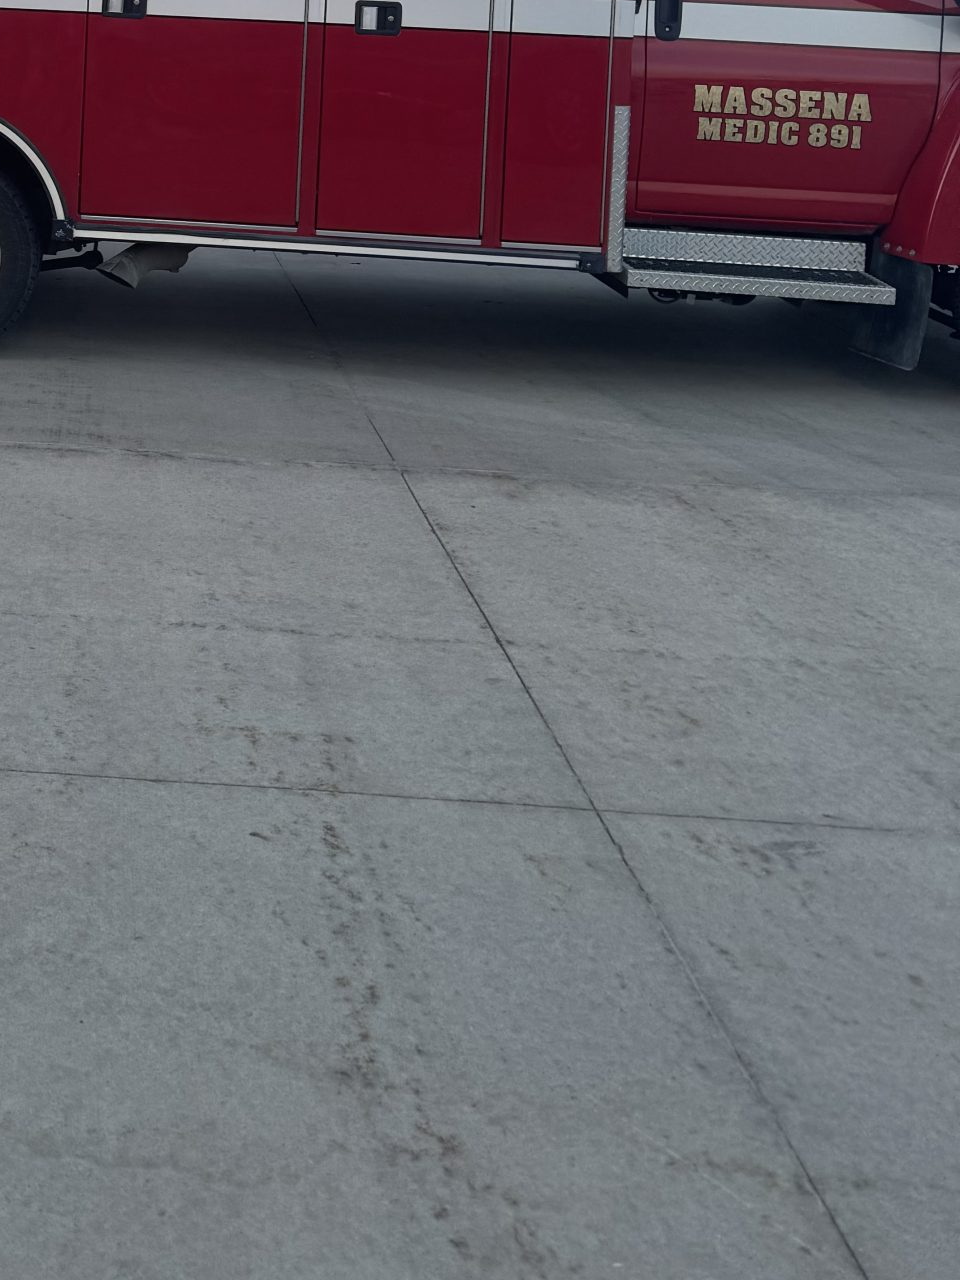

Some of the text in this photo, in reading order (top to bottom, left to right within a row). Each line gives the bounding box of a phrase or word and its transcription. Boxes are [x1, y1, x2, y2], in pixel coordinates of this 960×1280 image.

[693, 84, 872, 122] MASSENA
[696, 116, 862, 150] MEDIC 891
